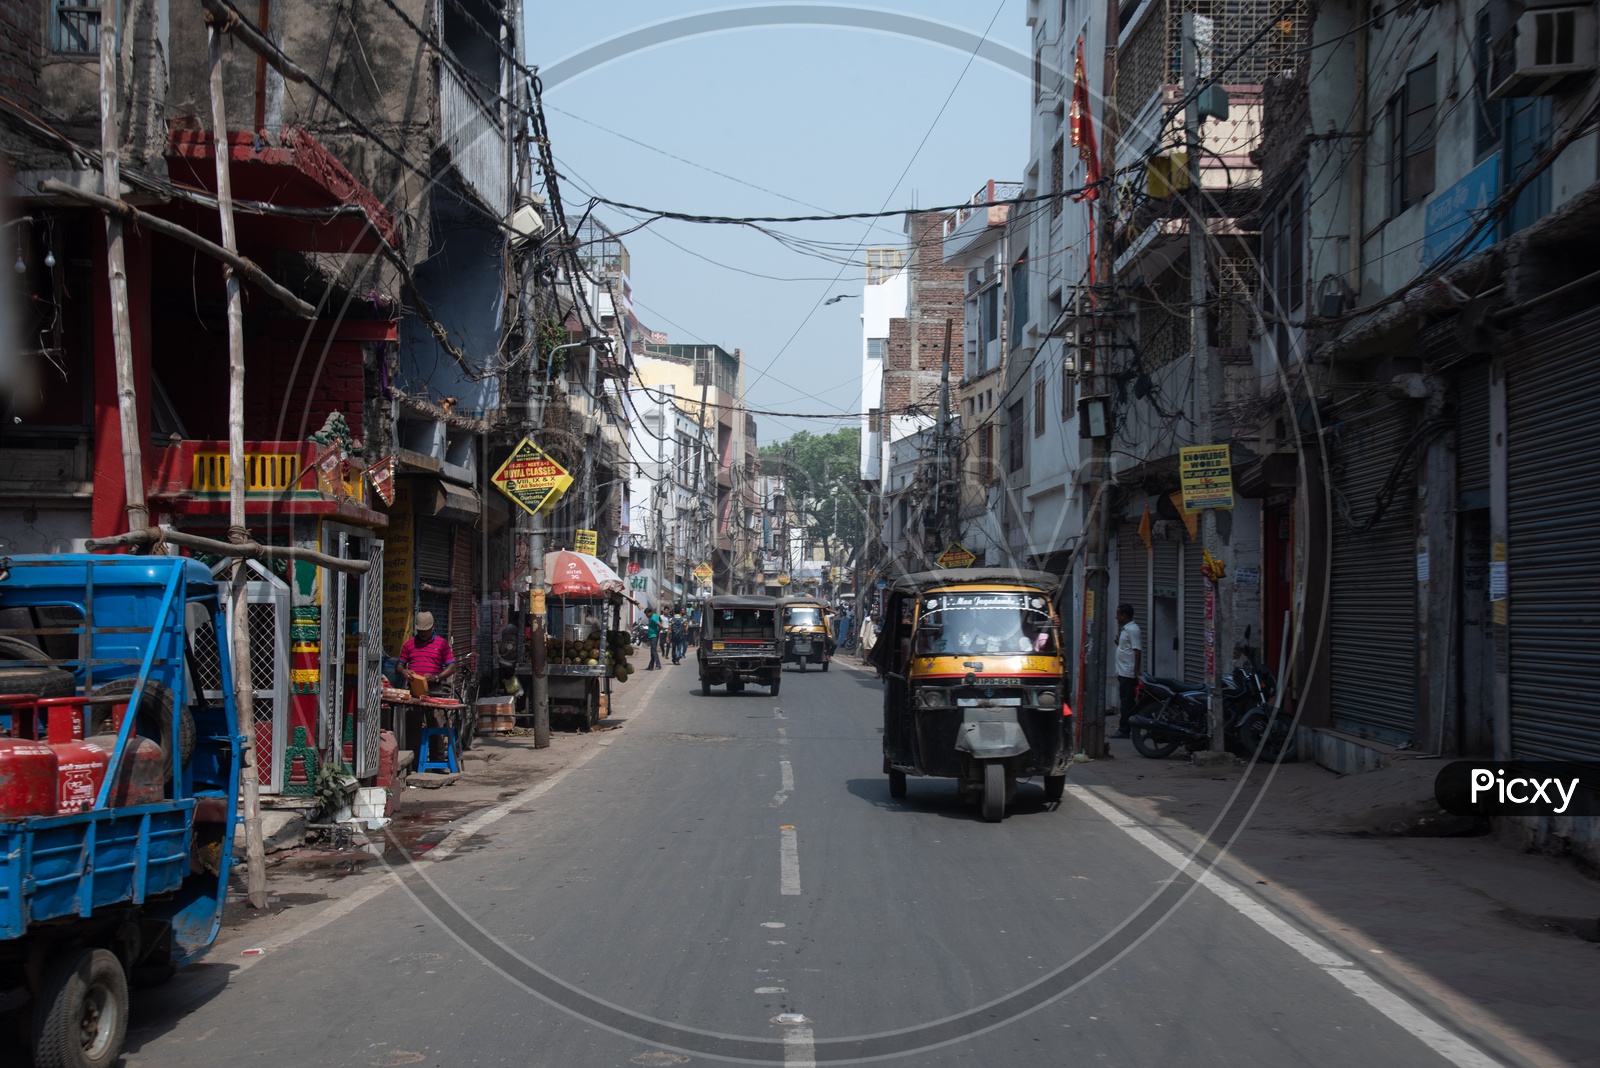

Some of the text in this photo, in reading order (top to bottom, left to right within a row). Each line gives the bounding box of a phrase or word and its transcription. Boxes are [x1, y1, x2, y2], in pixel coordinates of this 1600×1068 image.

[1183, 451, 1227, 461] KNOWLEDGE
[1190, 460, 1221, 468] WORLD
[503, 466, 556, 479] ROYAL CLASSES
